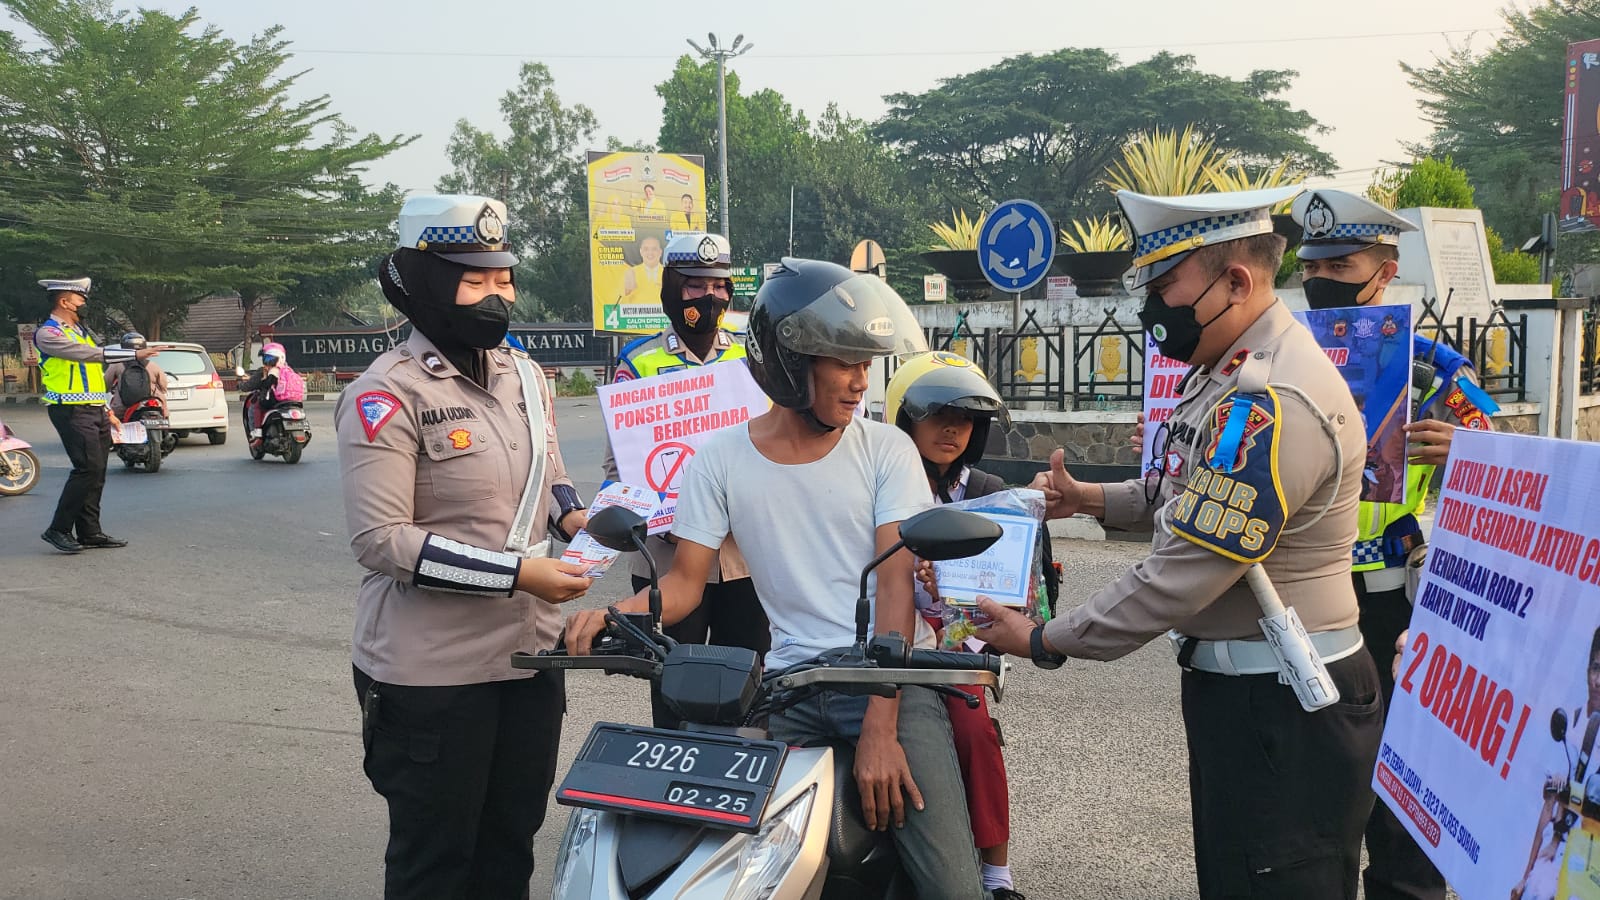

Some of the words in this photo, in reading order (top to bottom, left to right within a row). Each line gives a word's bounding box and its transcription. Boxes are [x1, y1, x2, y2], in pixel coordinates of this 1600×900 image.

[606, 310, 619, 329] 4
[301, 338, 396, 354] LEMBAGA
[609, 387, 655, 408] JANGAN
[658, 374, 714, 397] GUNAKAN
[614, 404, 670, 430] PONSEL
[673, 394, 711, 417] SAAT
[421, 408, 447, 426] AULA
[653, 406, 749, 442] BERKENDARA
[1446, 458, 1486, 496] JATUH
[1482, 465, 1504, 500] DI
[1497, 468, 1549, 512] ASPAL
[1194, 500, 1270, 551] OPS
[1438, 497, 1477, 537] TIDAK
[1471, 506, 1537, 559] SEINDAH
[1529, 523, 1585, 576] JATUH
[1428, 547, 1491, 598] KENDARAAN
[1486, 571, 1523, 614] RODA
[1517, 586, 1534, 619] 2
[1420, 581, 1455, 621] HANYA
[1451, 596, 1491, 641] UNTUK
[1400, 632, 1429, 695] 2
[627, 741, 700, 773] 2926
[725, 751, 767, 783] ZU
[1381, 743, 1392, 763] OPS
[1389, 751, 1405, 778] ZEBRA
[1422, 787, 1440, 816] 2023
[1438, 803, 1460, 838] POLRES
[1457, 825, 1480, 865] SUBANG
